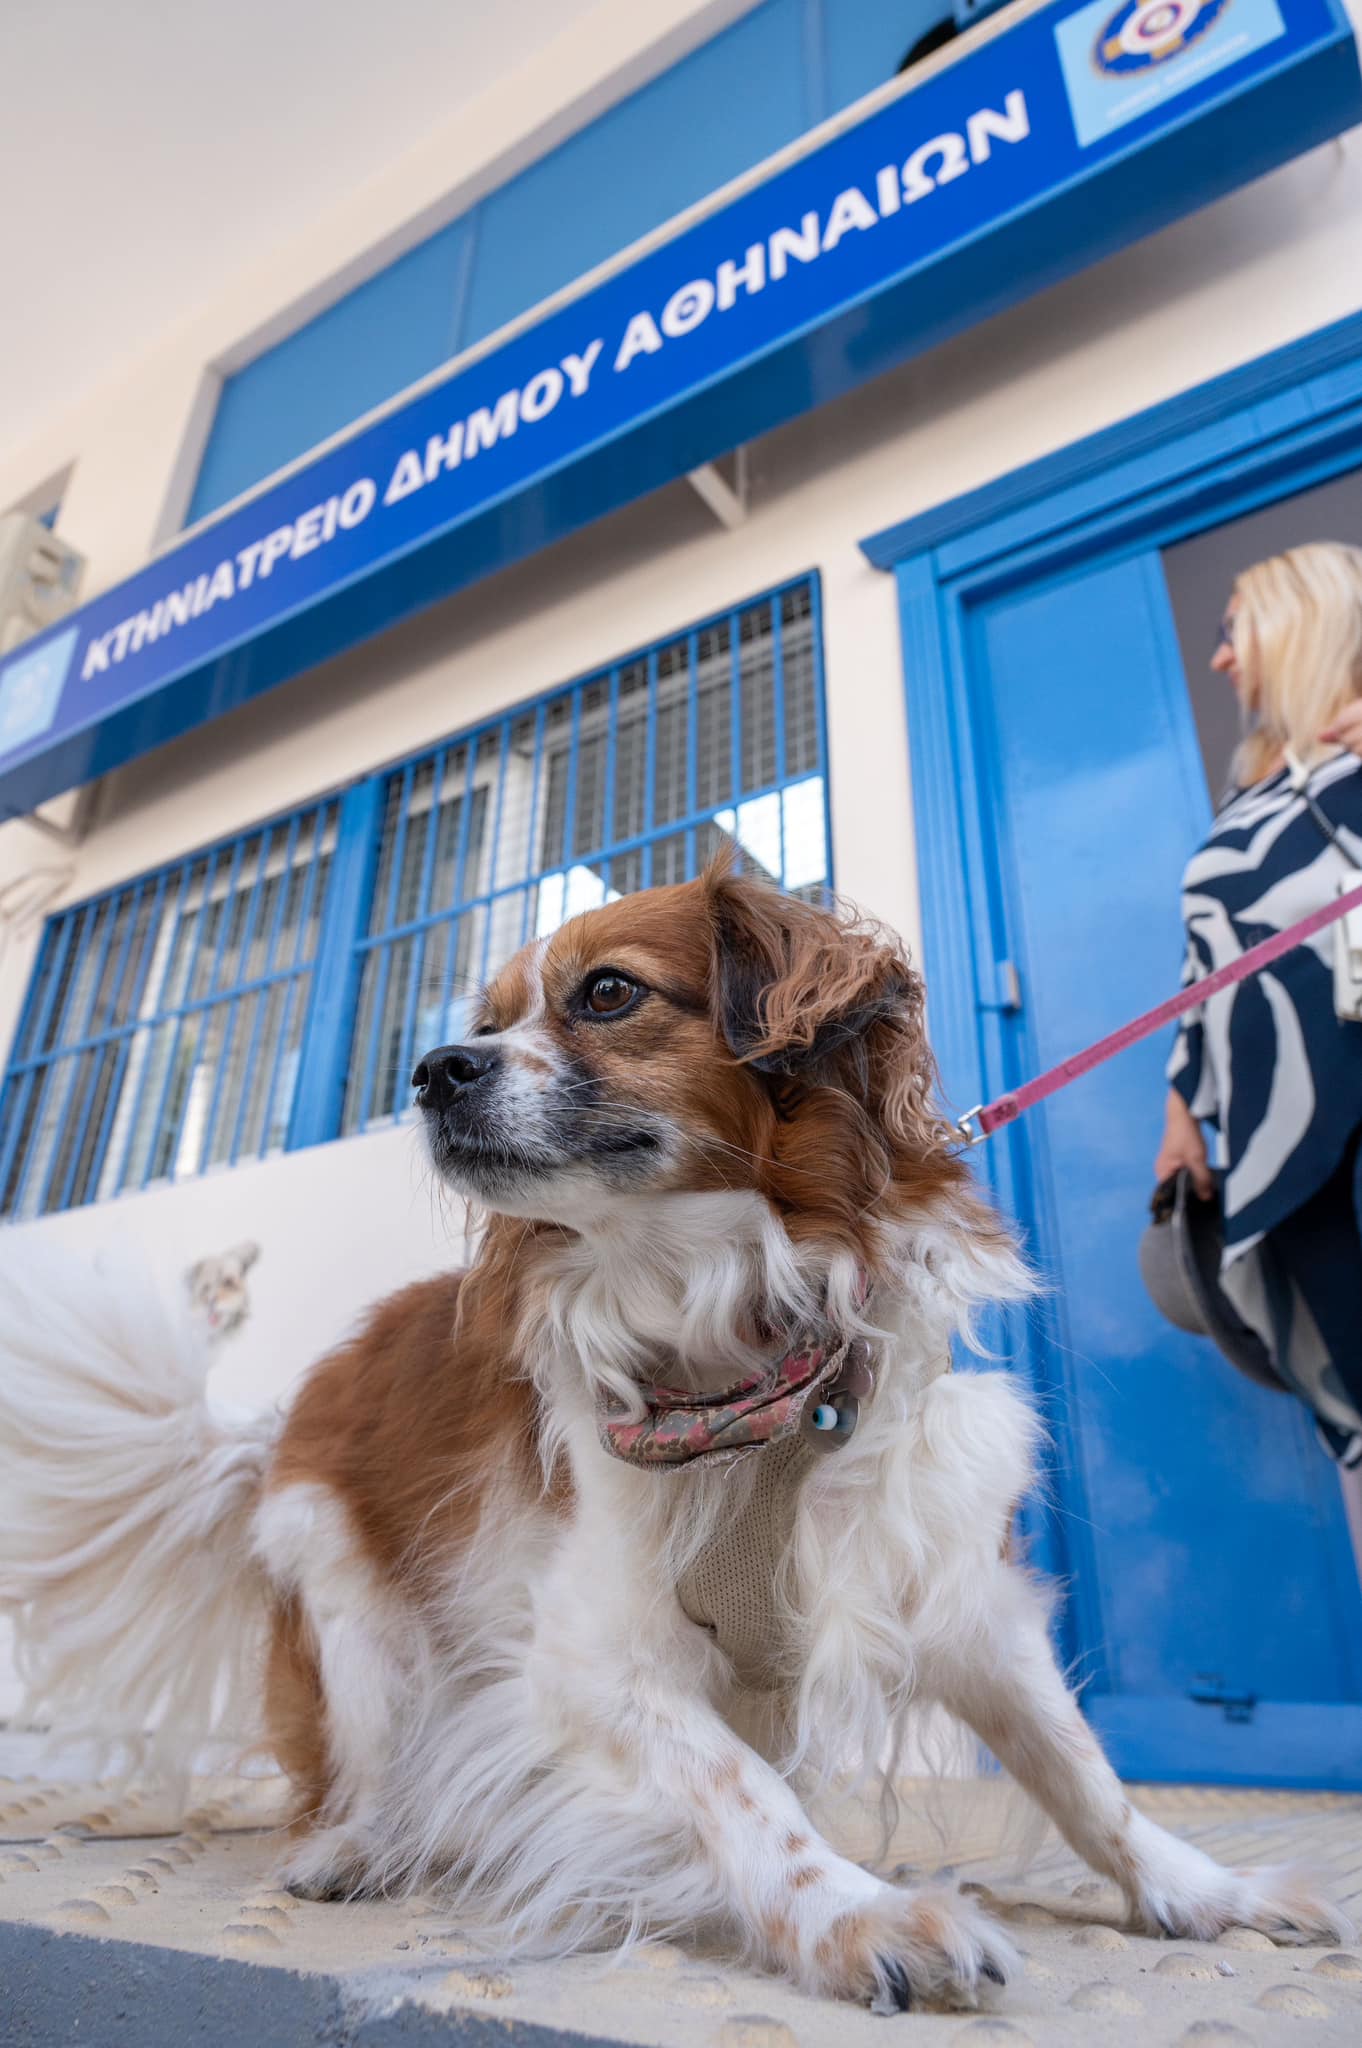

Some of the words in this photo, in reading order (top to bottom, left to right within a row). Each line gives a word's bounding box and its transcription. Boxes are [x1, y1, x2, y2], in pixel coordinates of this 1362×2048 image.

[80, 478, 376, 681] ΚΤΗΝΙΑΤΡΕΙΟ
[384, 340, 603, 505] ΔΗΜΟΥ
[615, 90, 1030, 371] ΑΘΗΝΑΙΩΝ
